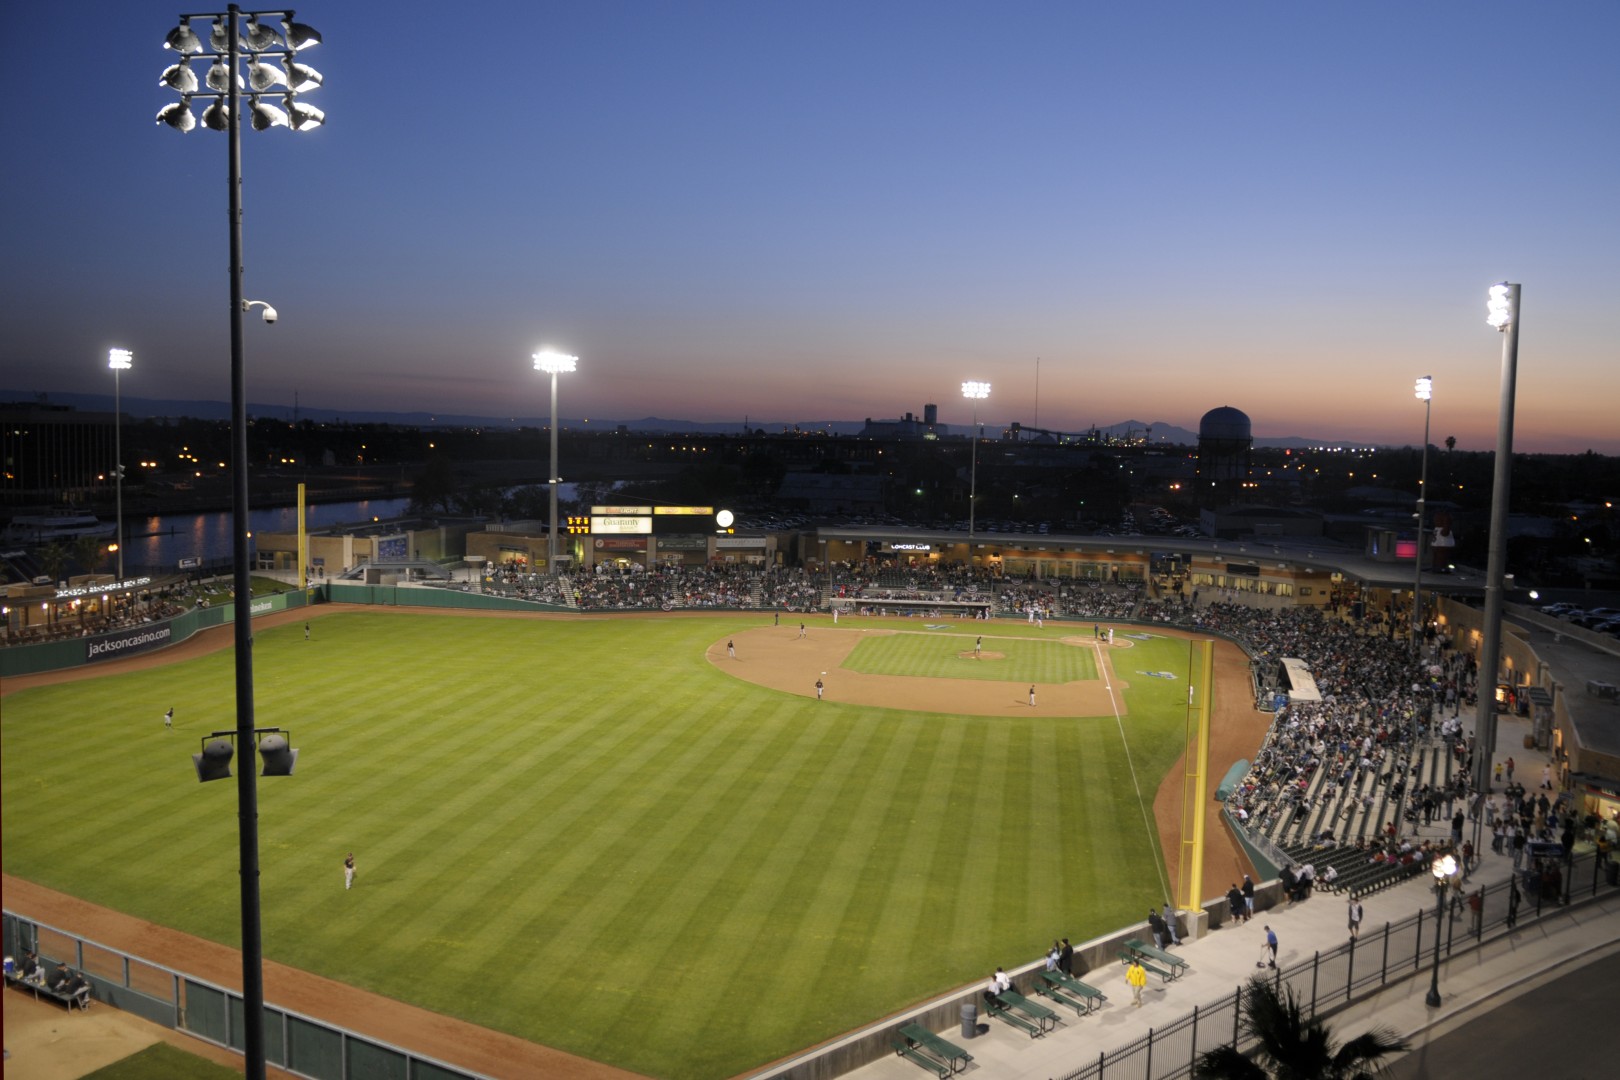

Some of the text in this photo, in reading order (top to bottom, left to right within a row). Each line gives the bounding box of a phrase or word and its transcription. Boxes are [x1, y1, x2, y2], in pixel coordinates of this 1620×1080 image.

[603, 518, 639, 526] Guaranty
[56, 588, 87, 598] JACKSON
[88, 628, 170, 658] jacksoncasino.com
